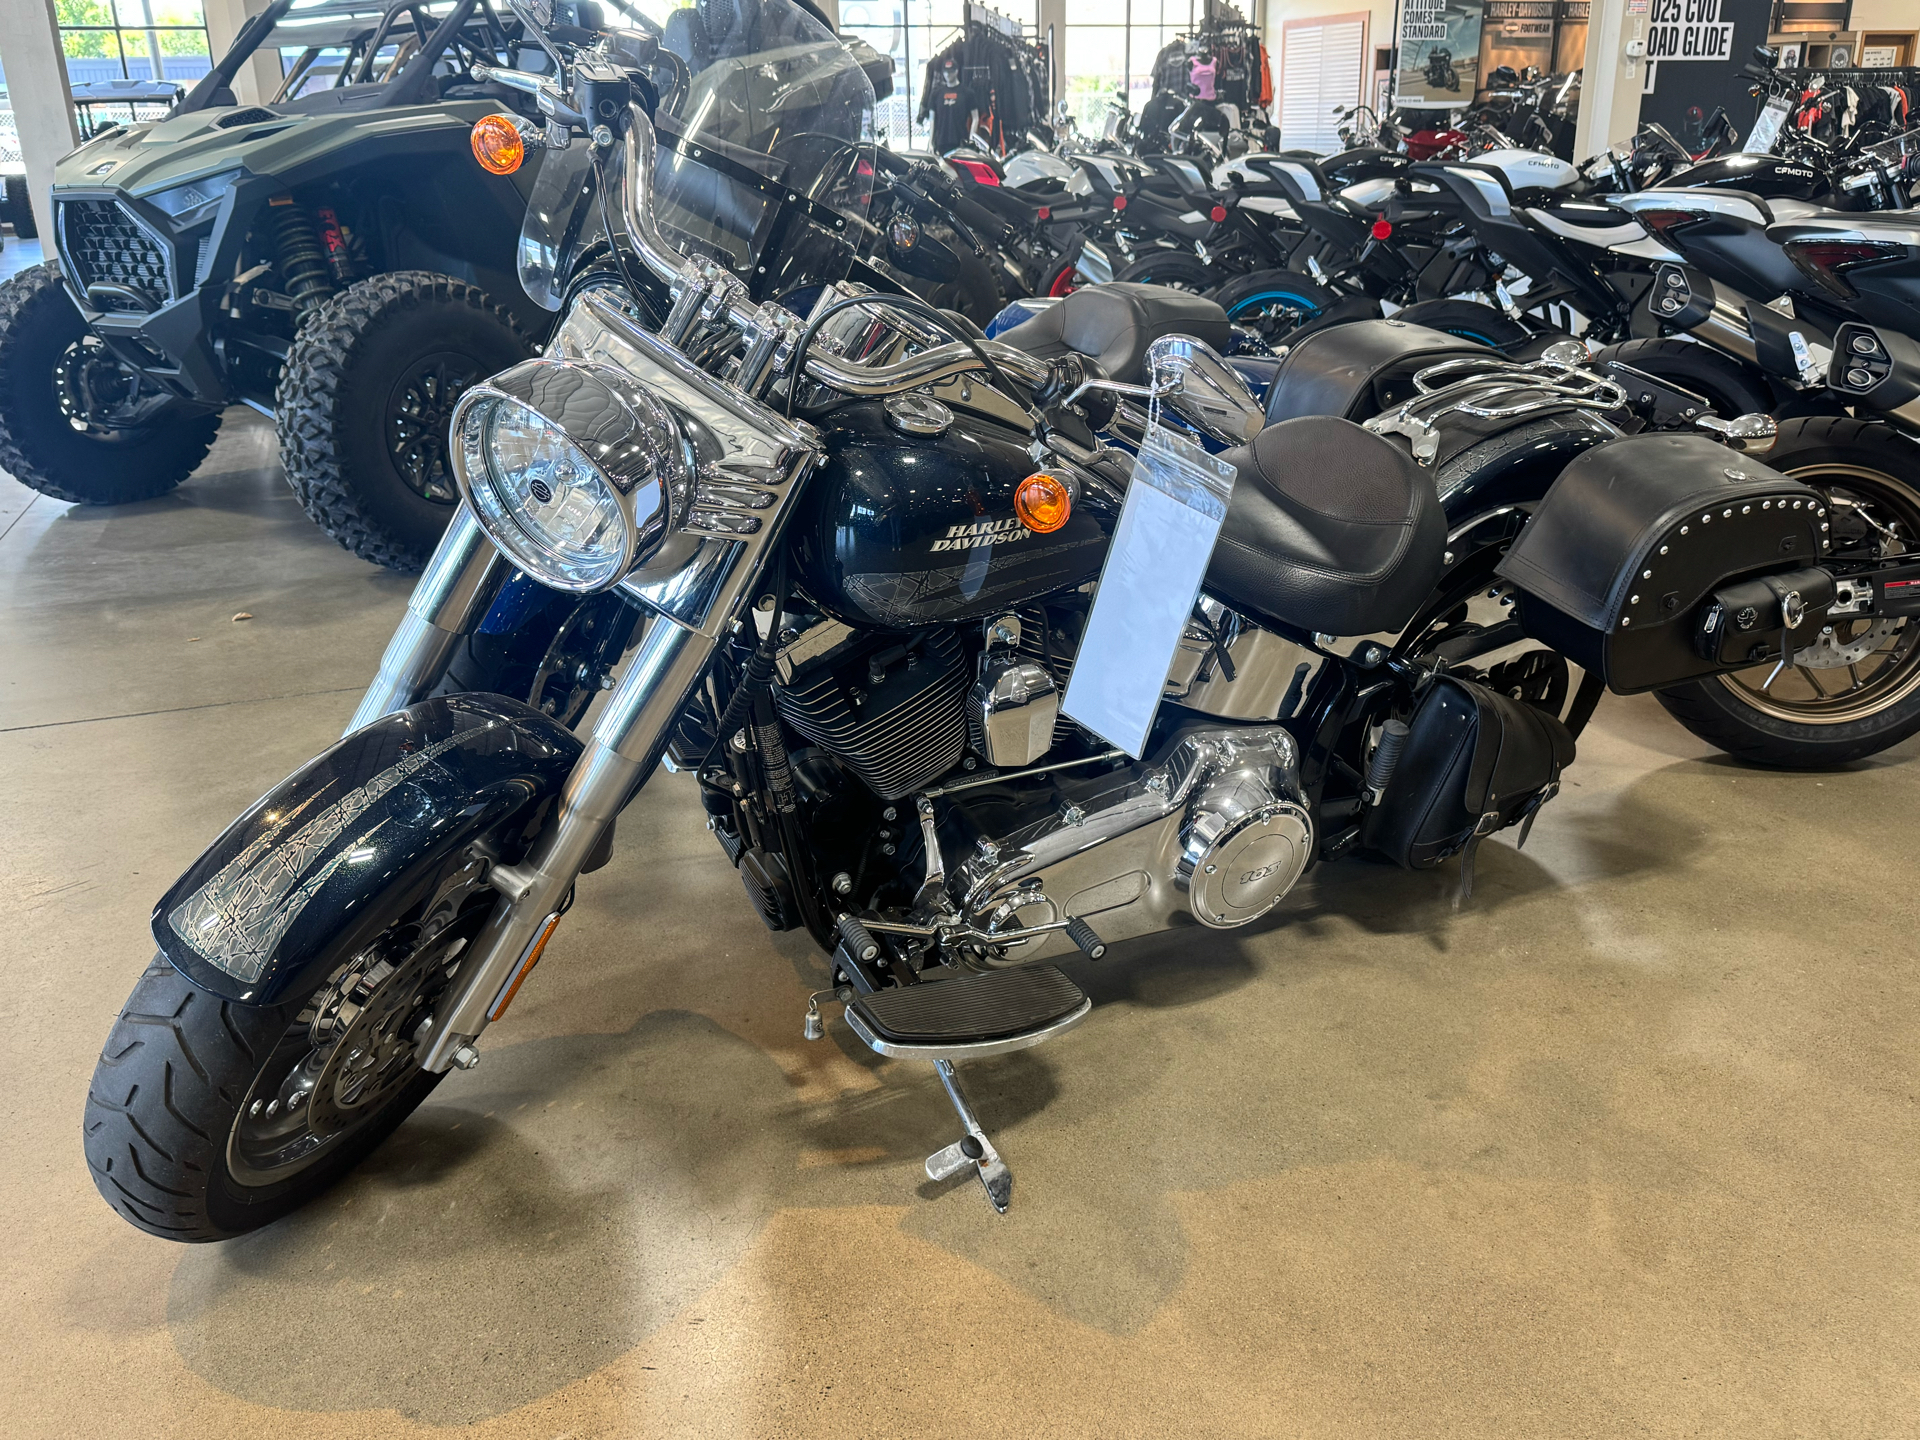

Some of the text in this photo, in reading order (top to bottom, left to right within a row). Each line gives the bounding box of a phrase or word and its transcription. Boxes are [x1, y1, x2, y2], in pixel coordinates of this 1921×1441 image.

[1403, 10, 1433, 24] COMES
[1489, 3, 1553, 17] HARLEY-DAVIDSON
[1685, 0, 1717, 23] CVO
[1402, 25, 1446, 39] STANDARD
[1519, 23, 1550, 33] FOOTWEAR
[1682, 26, 1729, 57] GLIDE
[1527, 160, 1560, 170] CFMOTO
[1774, 166, 1814, 178] CFMOTO
[928, 528, 1032, 552] DAVIDSON
